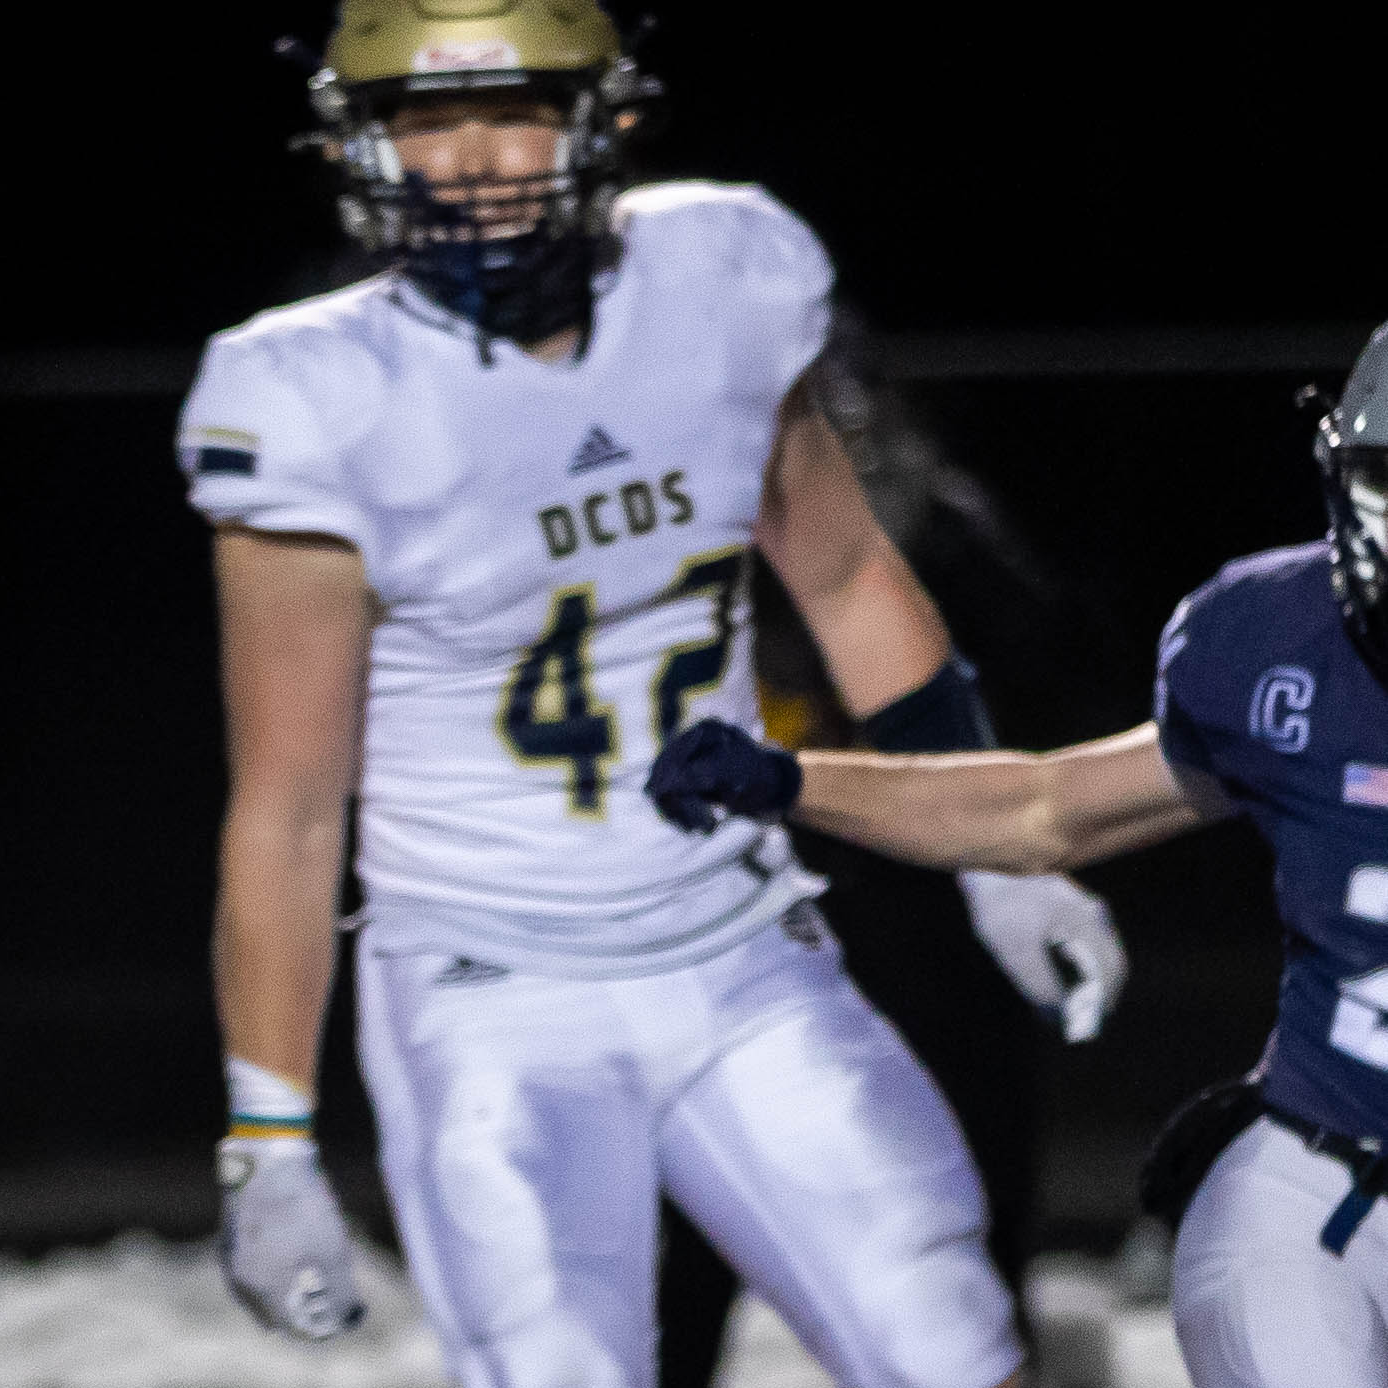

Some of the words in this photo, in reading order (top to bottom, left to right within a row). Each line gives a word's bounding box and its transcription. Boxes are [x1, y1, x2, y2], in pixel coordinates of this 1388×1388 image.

[536, 466, 696, 561] DCDS
[494, 543, 763, 823] 42
[1247, 663, 1316, 755] C
